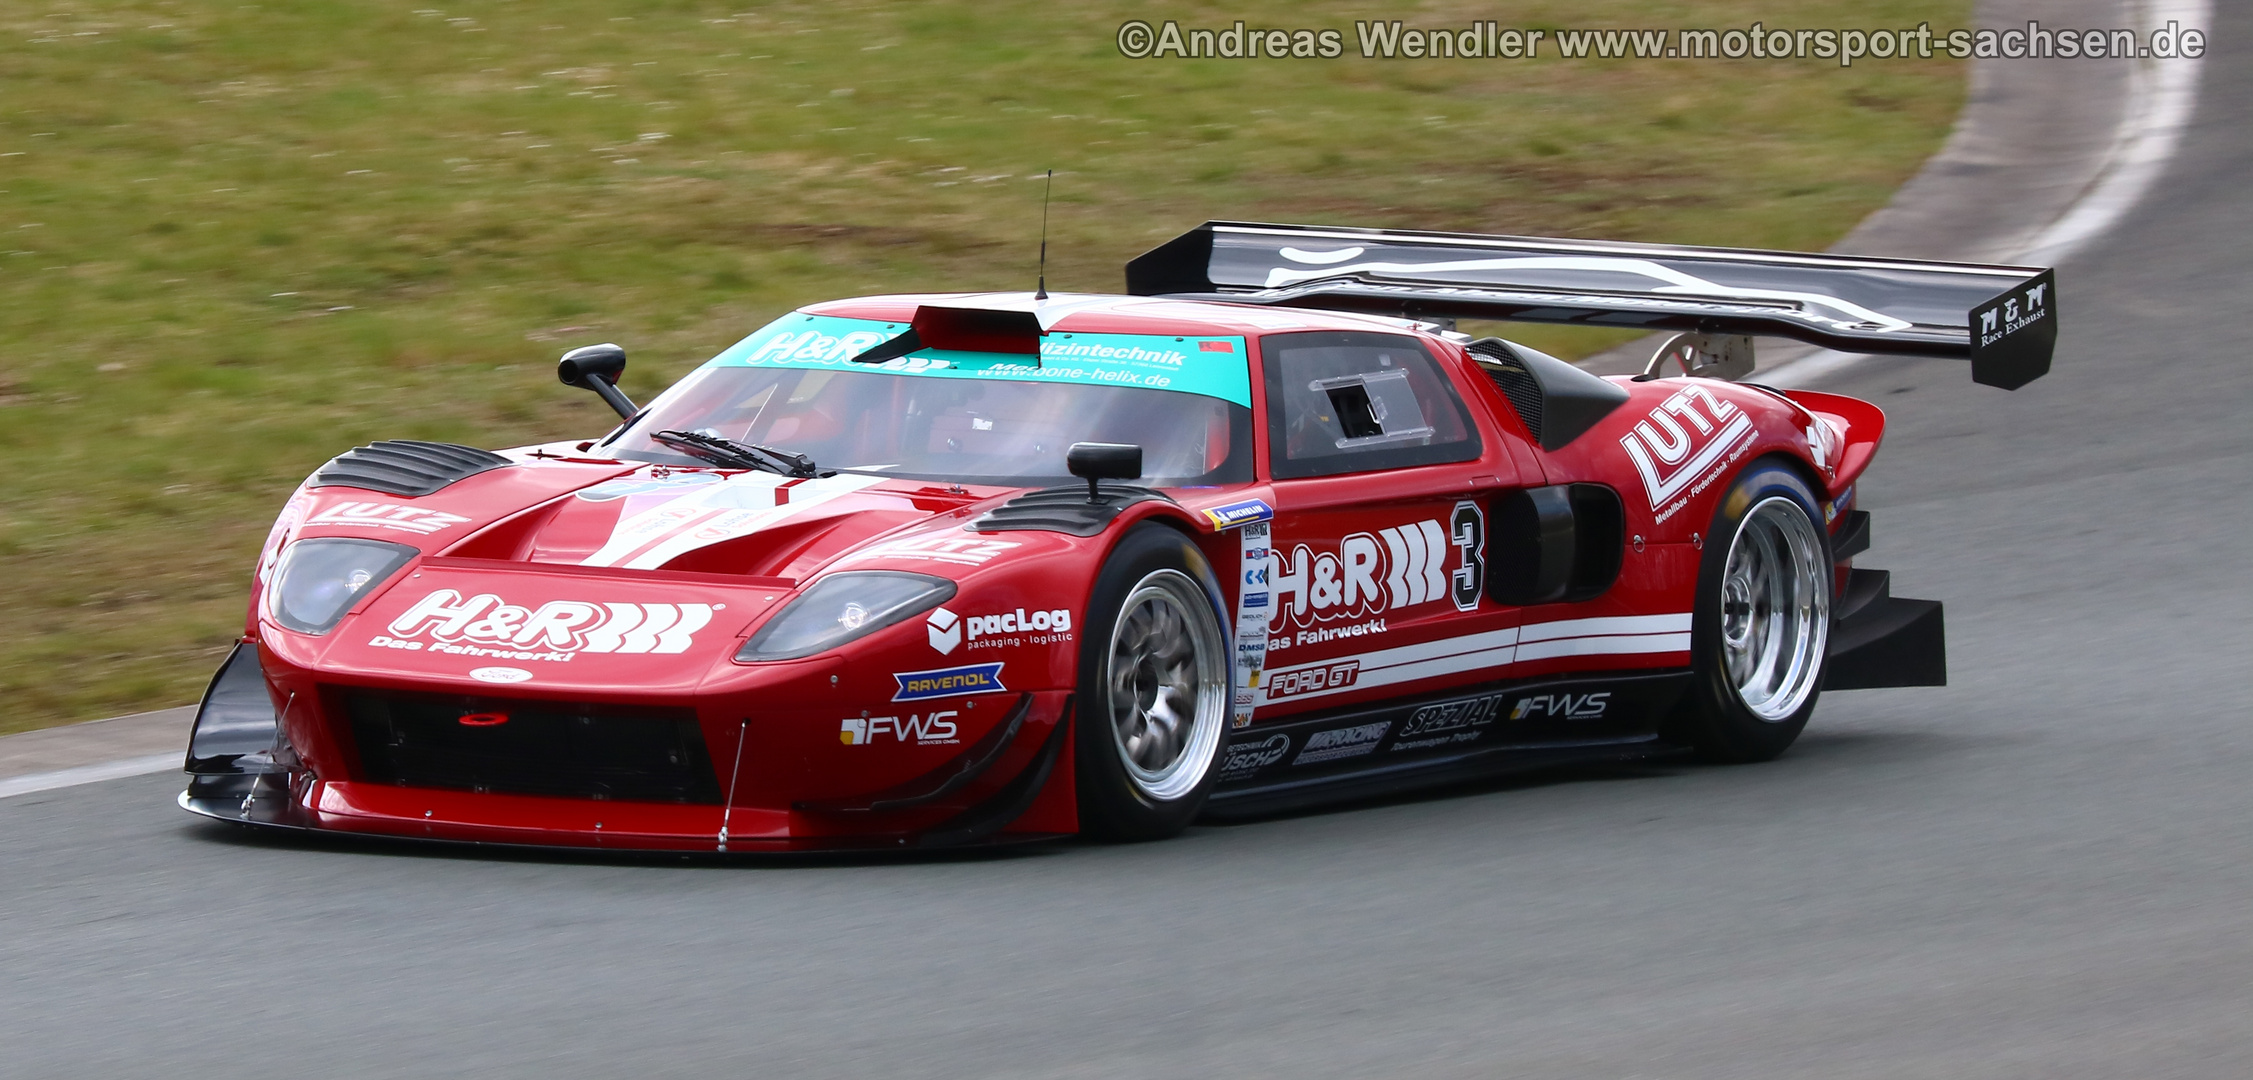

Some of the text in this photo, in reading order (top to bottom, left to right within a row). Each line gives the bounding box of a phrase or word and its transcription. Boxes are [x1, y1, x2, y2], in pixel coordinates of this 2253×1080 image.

[1980, 308, 2045, 348] Race Exhaust
[1619, 383, 1753, 512] LUTZ
[1654, 429, 1760, 526] Metallbau Fördertechnik Raumsysteme
[306, 501, 472, 533] LUTZ
[1226, 505, 1265, 519] MICHELIN
[1268, 500, 1485, 634] H&R 3
[388, 589, 606, 650] H&R
[966, 608, 1072, 640] pacLog
[1296, 619, 1388, 647] Fahrwerk!
[368, 636, 577, 663] Das Fahrwerk!
[968, 632, 1073, 650] packaging logistic
[907, 673, 990, 692] RAVENOL
[1269, 663, 1359, 697] FORD GT
[1399, 694, 1503, 737] SPEZIAL
[1521, 692, 1611, 719] FWS
[865, 711, 958, 744] FWS
